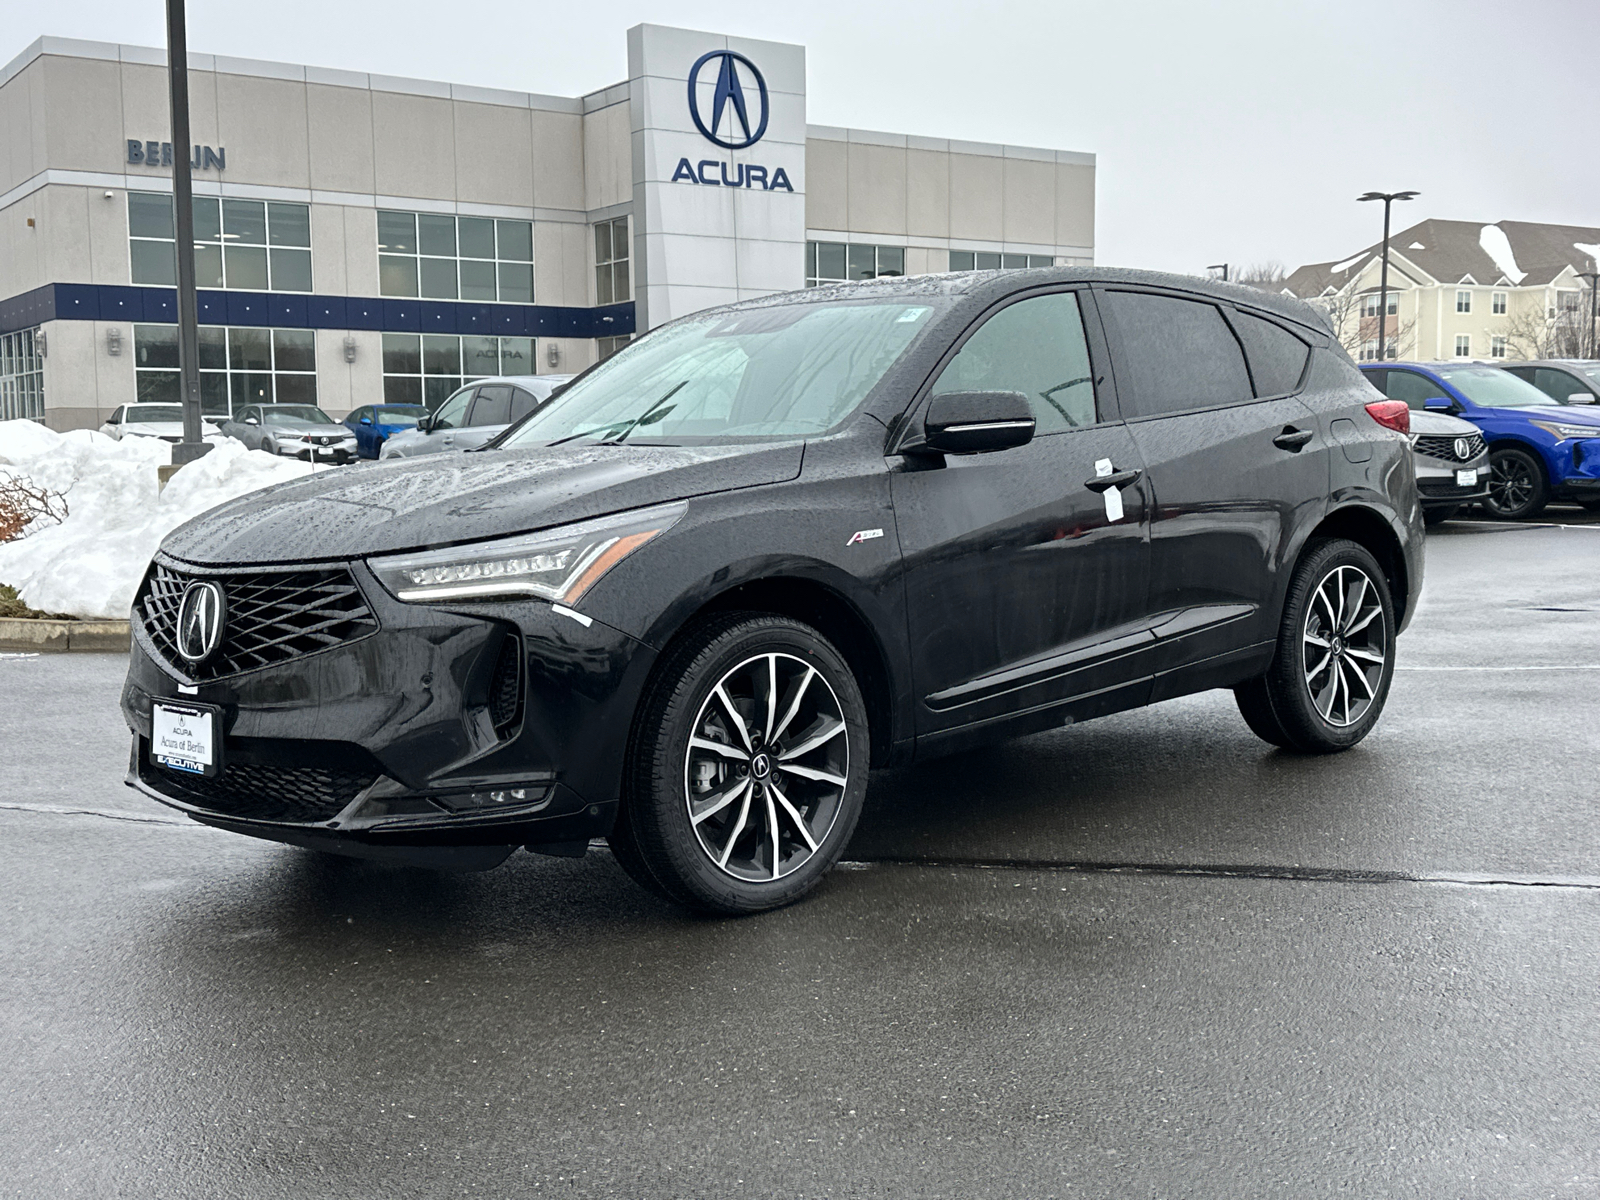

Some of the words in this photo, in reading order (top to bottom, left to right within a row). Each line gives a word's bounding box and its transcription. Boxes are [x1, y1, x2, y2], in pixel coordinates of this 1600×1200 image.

[127, 139, 226, 170] BERIN
[671, 157, 794, 192] ACURA
[173, 727, 193, 737] ACURA
[161, 736, 178, 749] Acura
[179, 741, 186, 750] of
[187, 740, 205, 754] Berlin
[157, 755, 204, 771] EXECUTIVE
